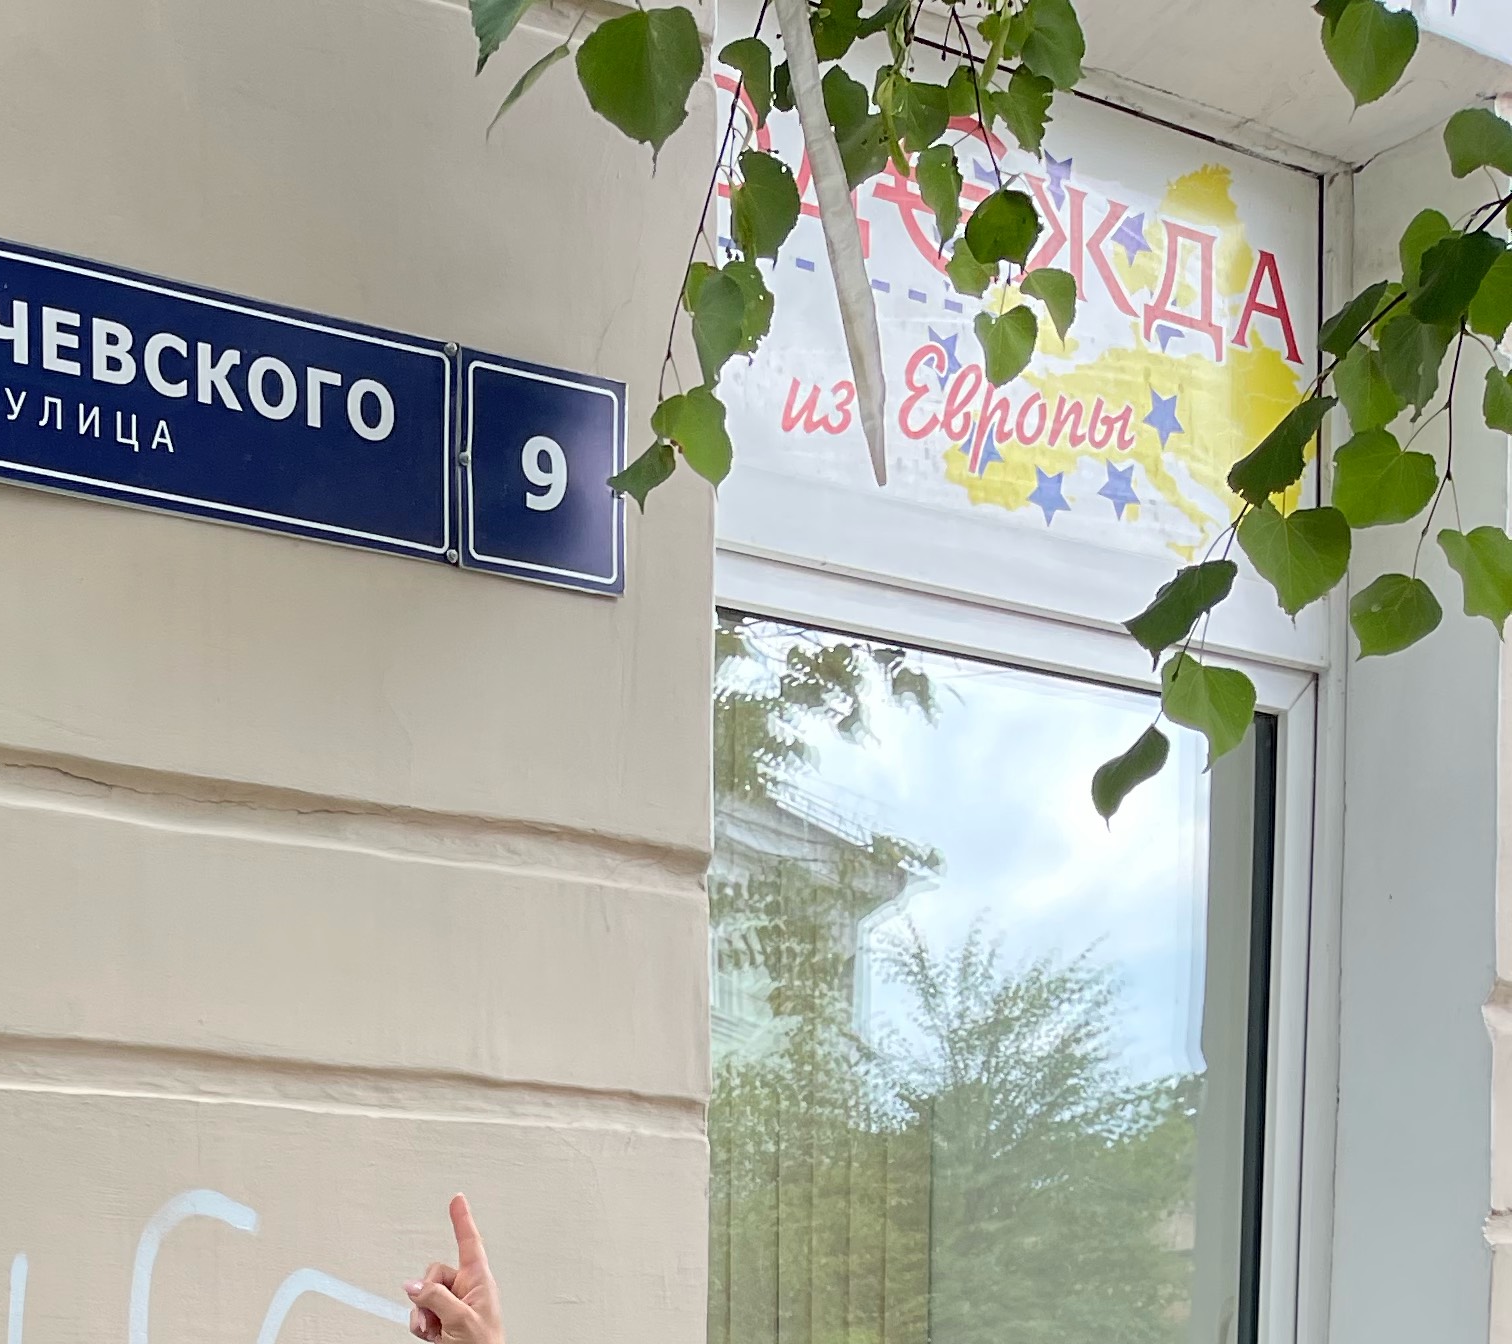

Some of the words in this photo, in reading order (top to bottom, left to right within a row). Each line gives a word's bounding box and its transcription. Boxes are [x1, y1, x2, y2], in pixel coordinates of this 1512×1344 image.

[3, 386, 175, 454] УЛИЦА
[780, 377, 856, 435] из
[897, 343, 1136, 474] Европы
[520, 434, 569, 512] 9
